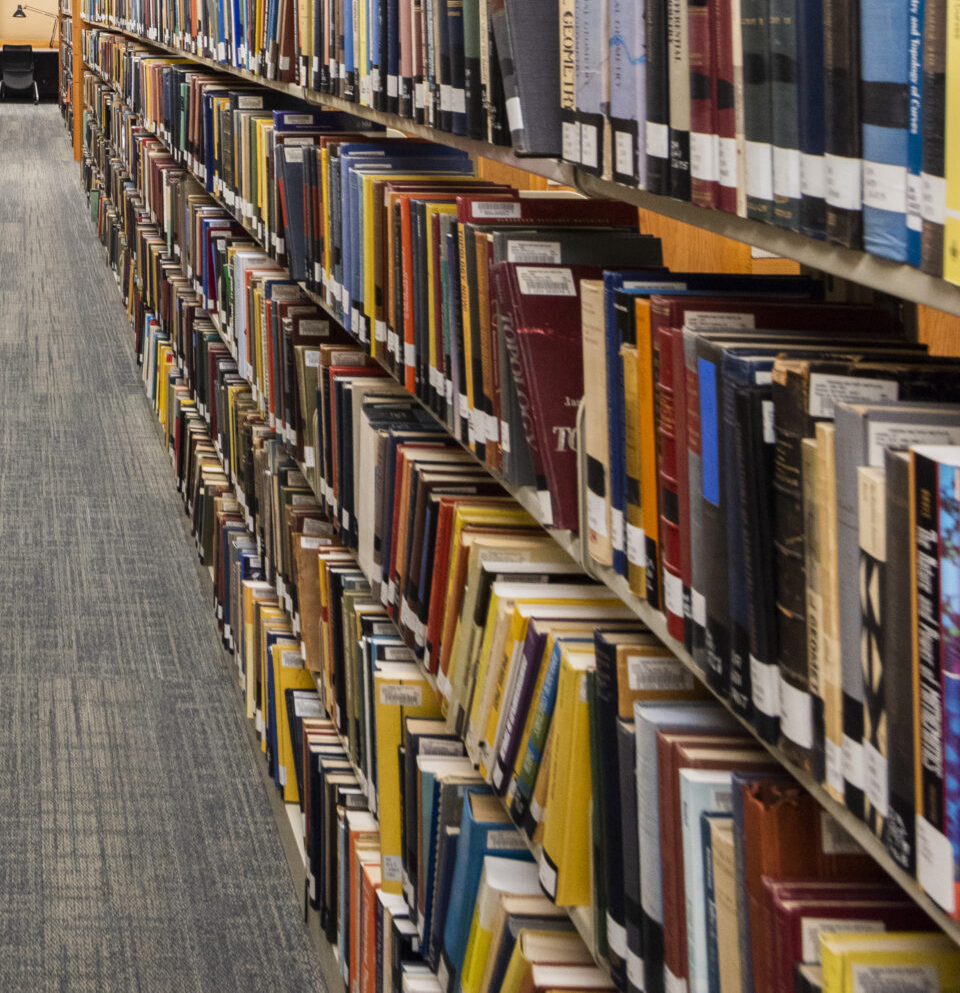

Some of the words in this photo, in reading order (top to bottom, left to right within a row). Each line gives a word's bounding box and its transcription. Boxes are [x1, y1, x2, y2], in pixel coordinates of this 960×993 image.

[911, 16, 922, 36] and
[561, 9, 577, 114] GEOMETRY
[910, 39, 922, 83] Topology
[911, 85, 922, 98] of
[911, 98, 921, 134] Curves
[457, 229, 467, 282] TOPOLOGY
[500, 310, 538, 451] TOPOLOGY
[917, 526, 939, 551] The
[918, 550, 939, 595] Nature
[919, 594, 940, 627] and
[919, 620, 941, 668] Power
